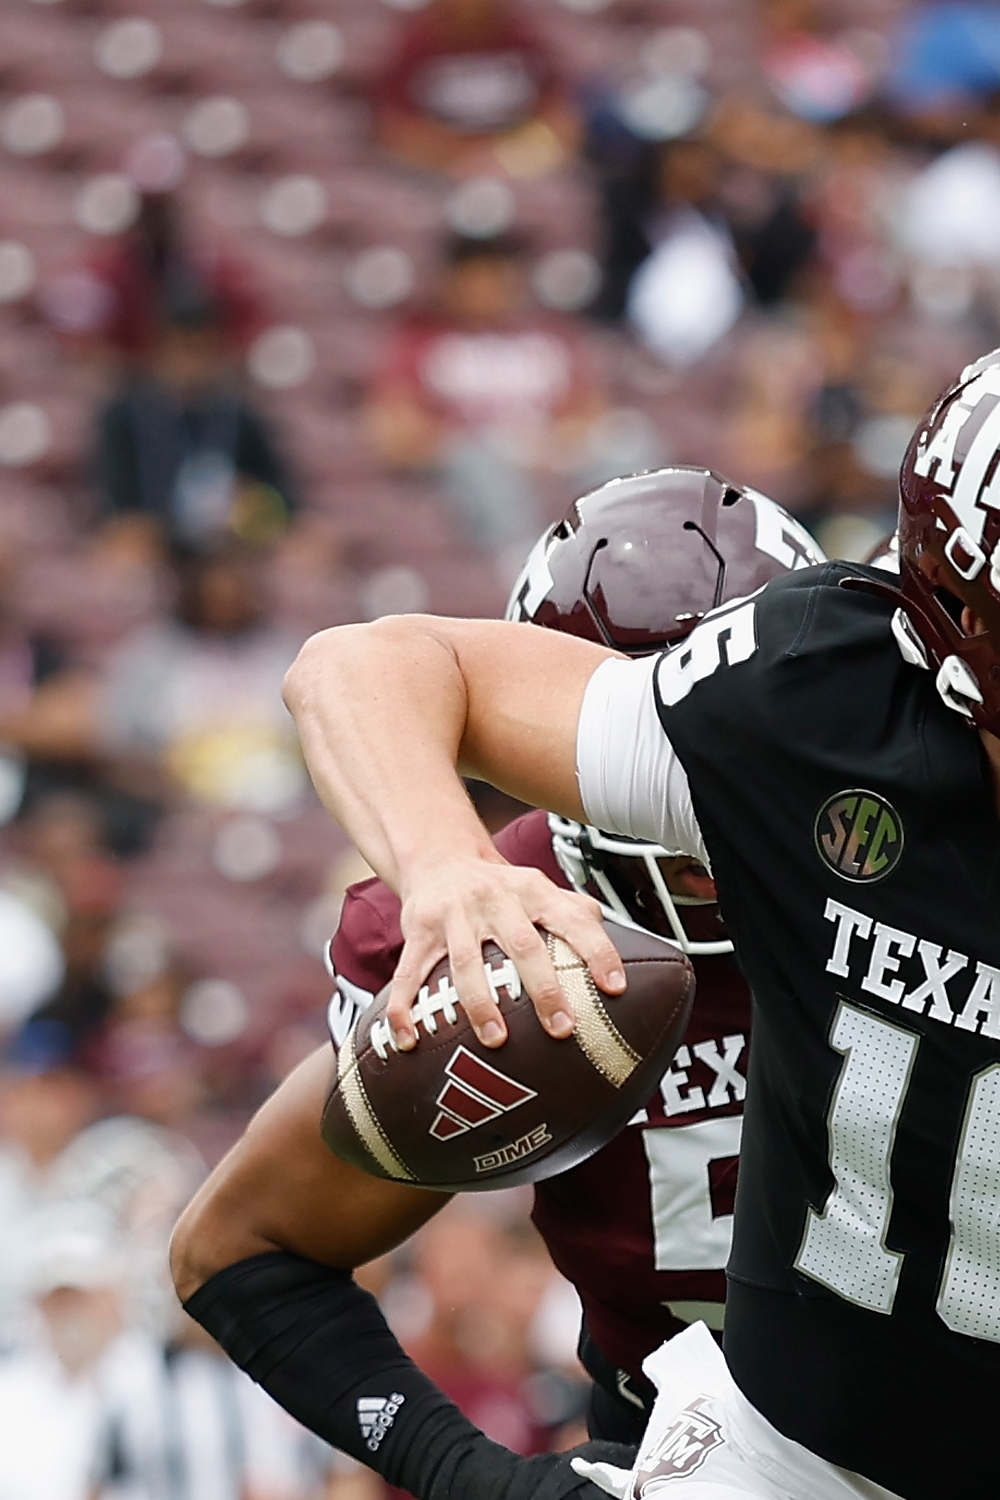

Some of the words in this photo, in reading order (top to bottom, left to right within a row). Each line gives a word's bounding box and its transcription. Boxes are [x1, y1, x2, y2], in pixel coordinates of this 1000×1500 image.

[820, 796, 898, 876] SEC
[627, 1033, 748, 1126] EX
[473, 1122, 553, 1173] DIME
[366, 1391, 406, 1452] adidas
